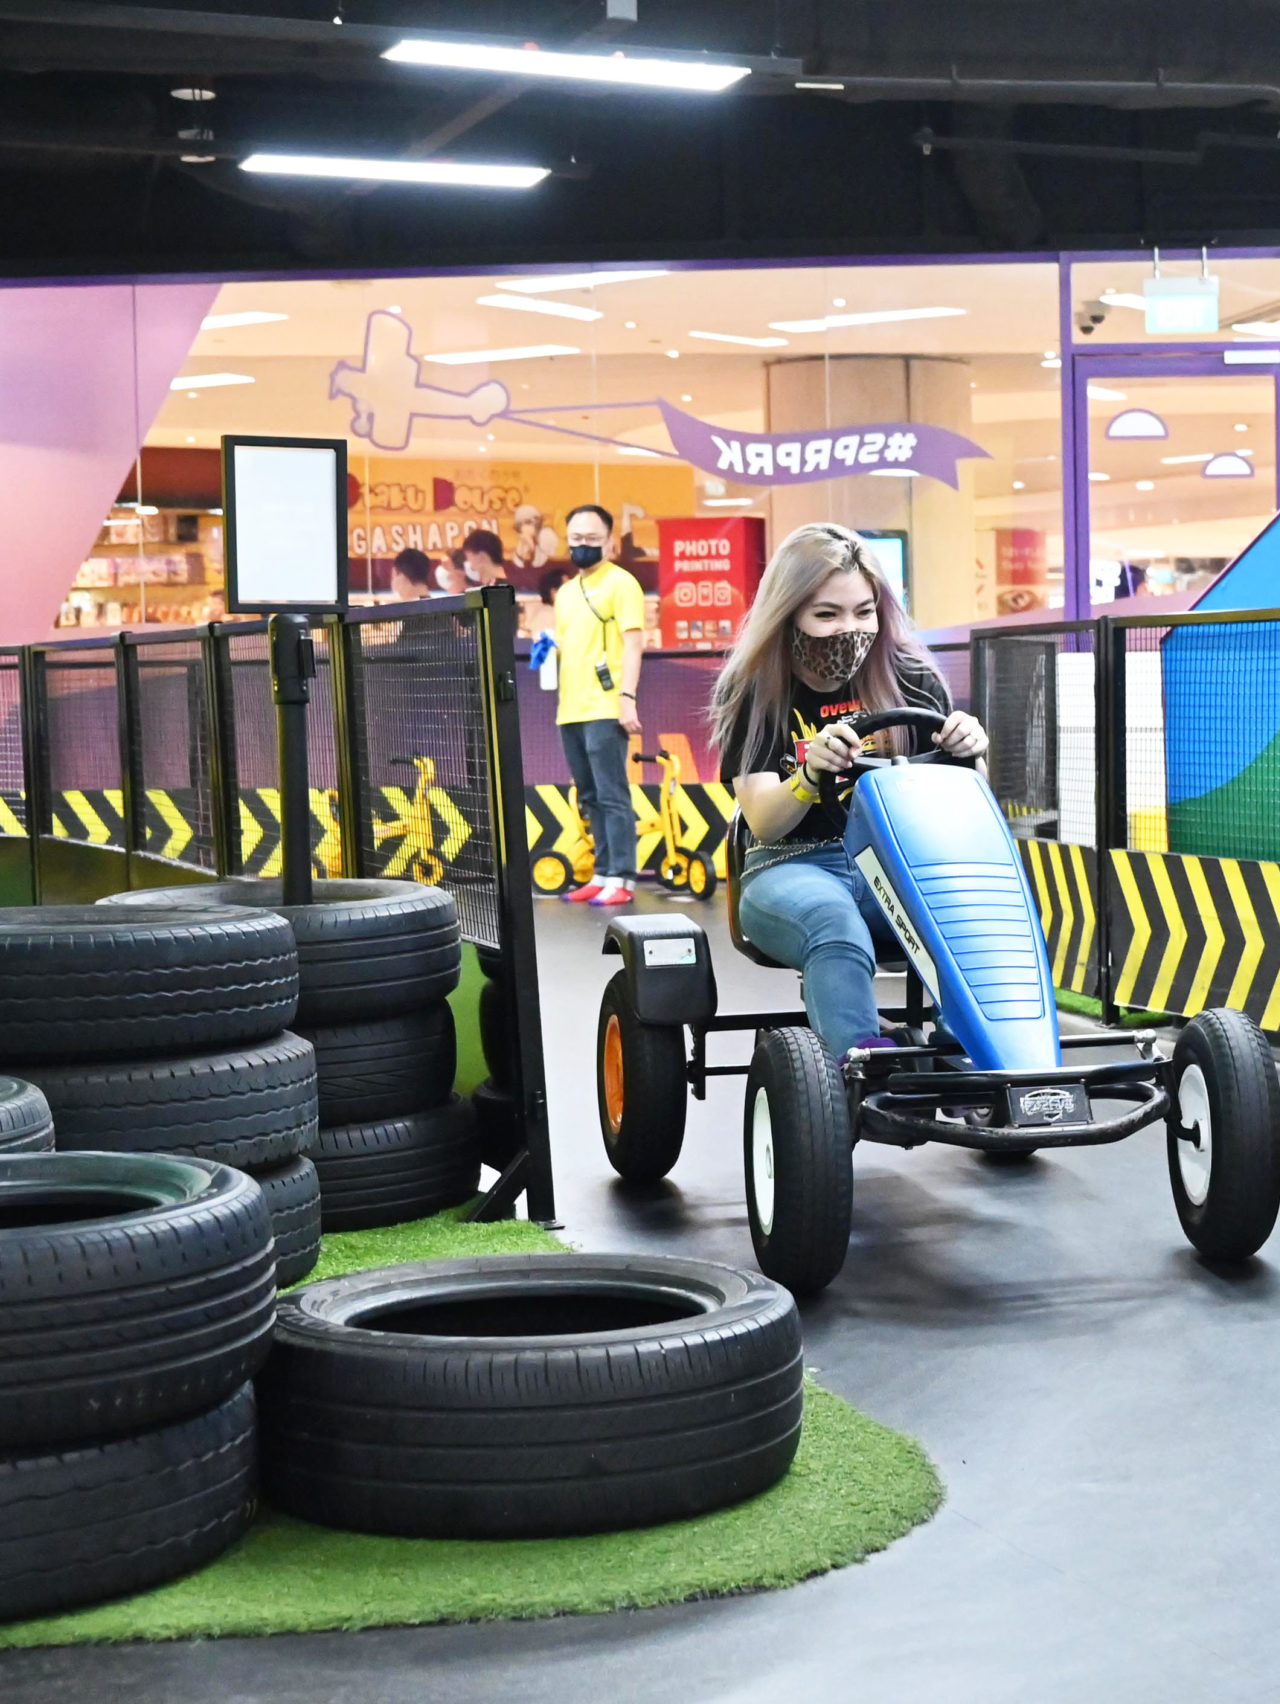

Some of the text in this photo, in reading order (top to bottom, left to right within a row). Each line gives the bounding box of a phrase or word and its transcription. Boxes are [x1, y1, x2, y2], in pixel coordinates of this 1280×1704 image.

[673, 538, 731, 557] PHOTO
[673, 558, 731, 573] PRINTING
[873, 875, 921, 954] EXTRA SPORT
